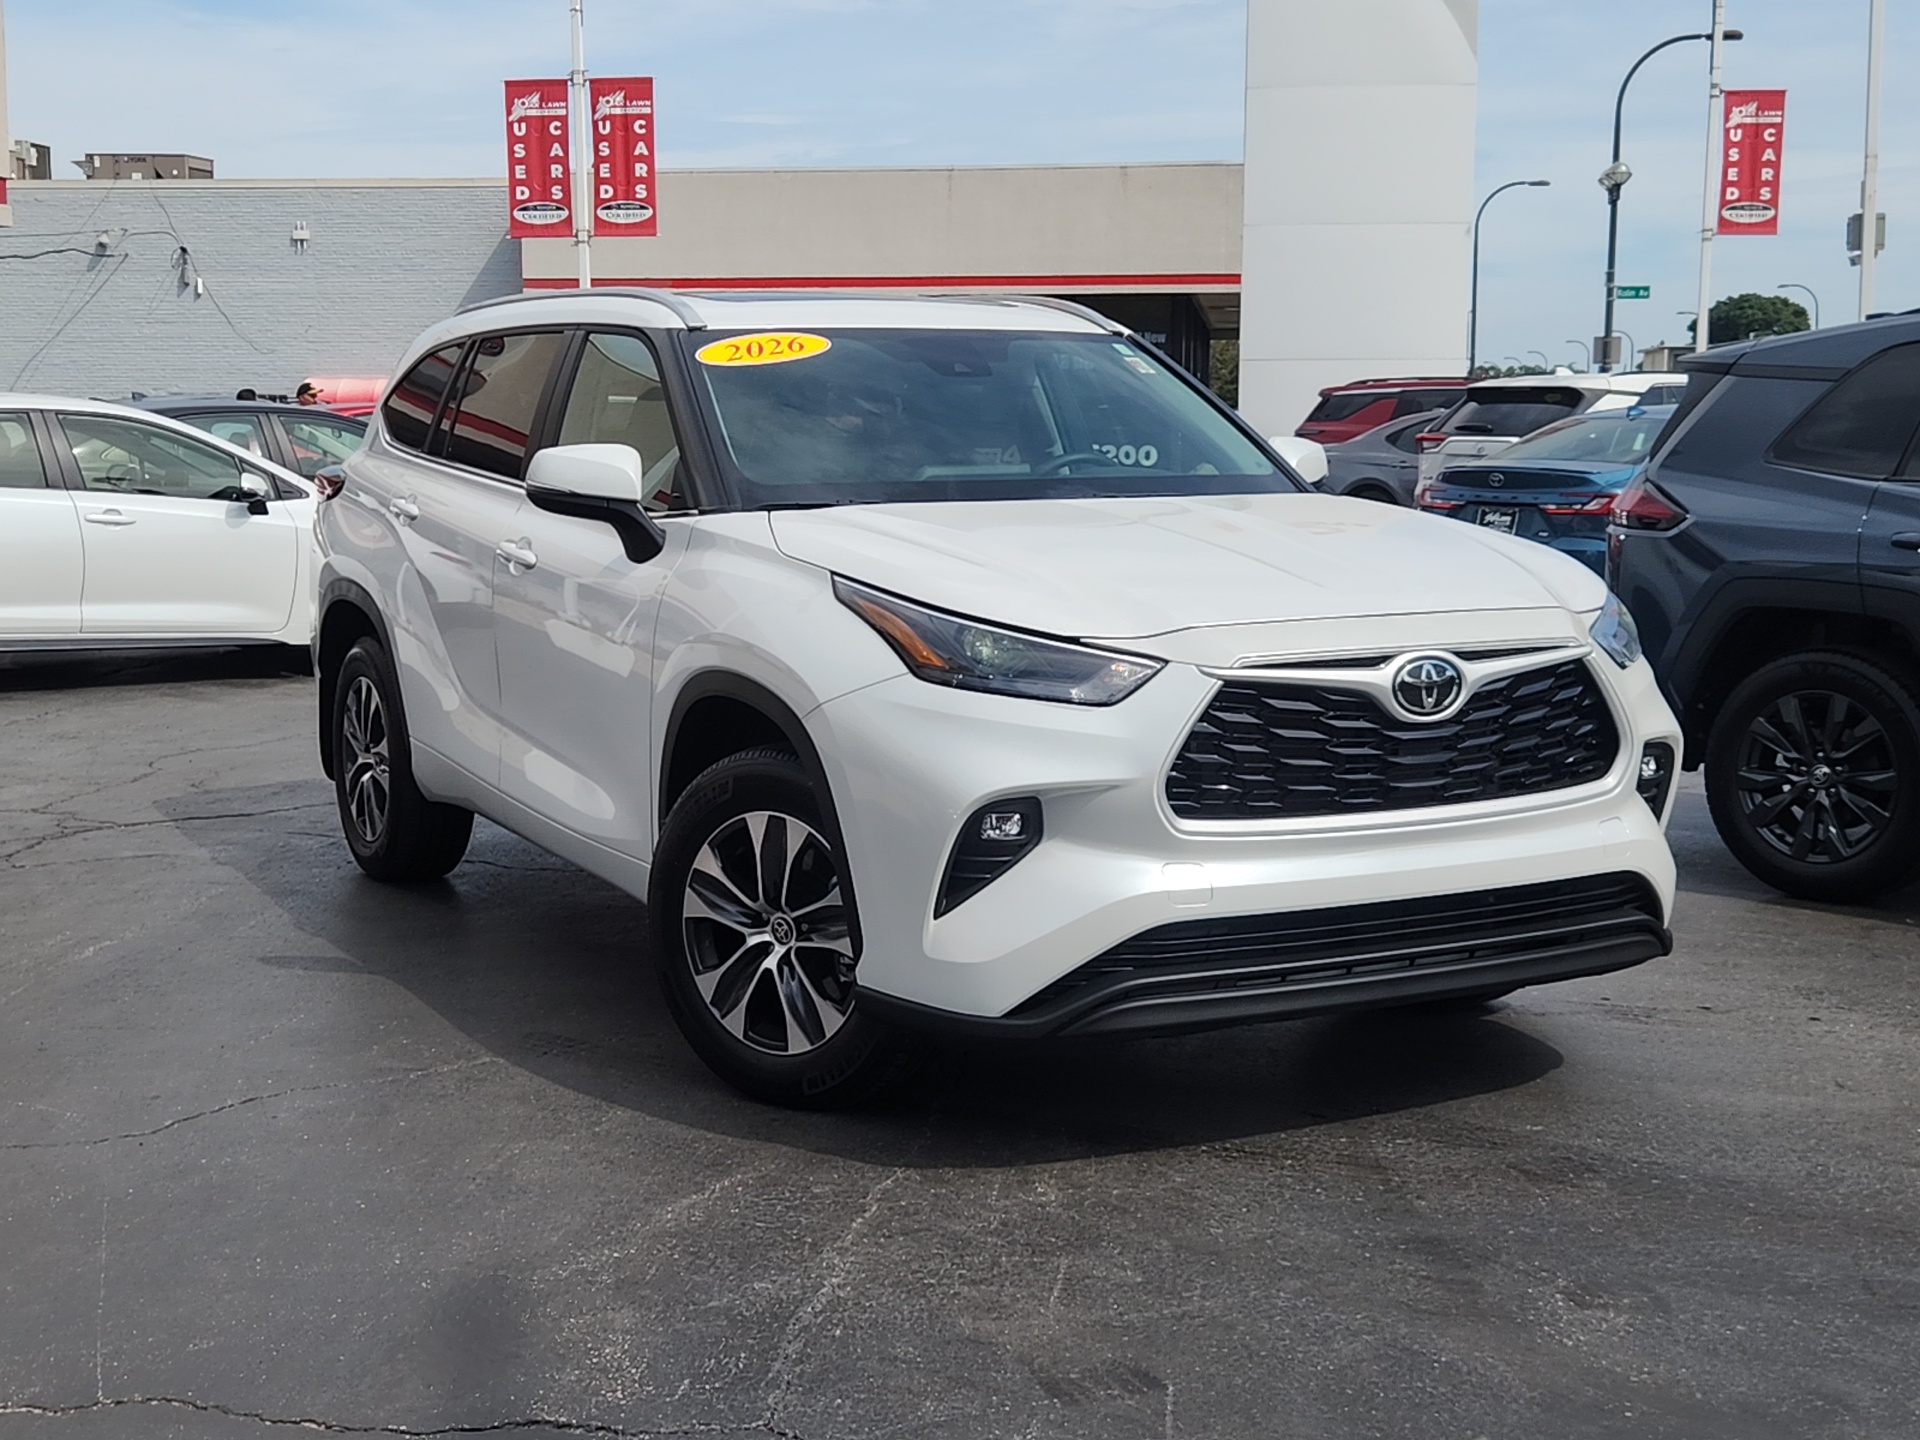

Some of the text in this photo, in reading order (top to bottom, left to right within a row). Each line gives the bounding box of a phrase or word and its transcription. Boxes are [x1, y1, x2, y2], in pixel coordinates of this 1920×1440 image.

[513, 122, 530, 200] USED
[549, 121, 564, 200] CARS
[598, 120, 614, 199] USED
[633, 120, 649, 199] CARS
[1725, 128, 1742, 200] USED
[1759, 128, 1776, 200] CARS
[724, 336, 805, 362] 2026
[1092, 444, 1159, 467] 200
